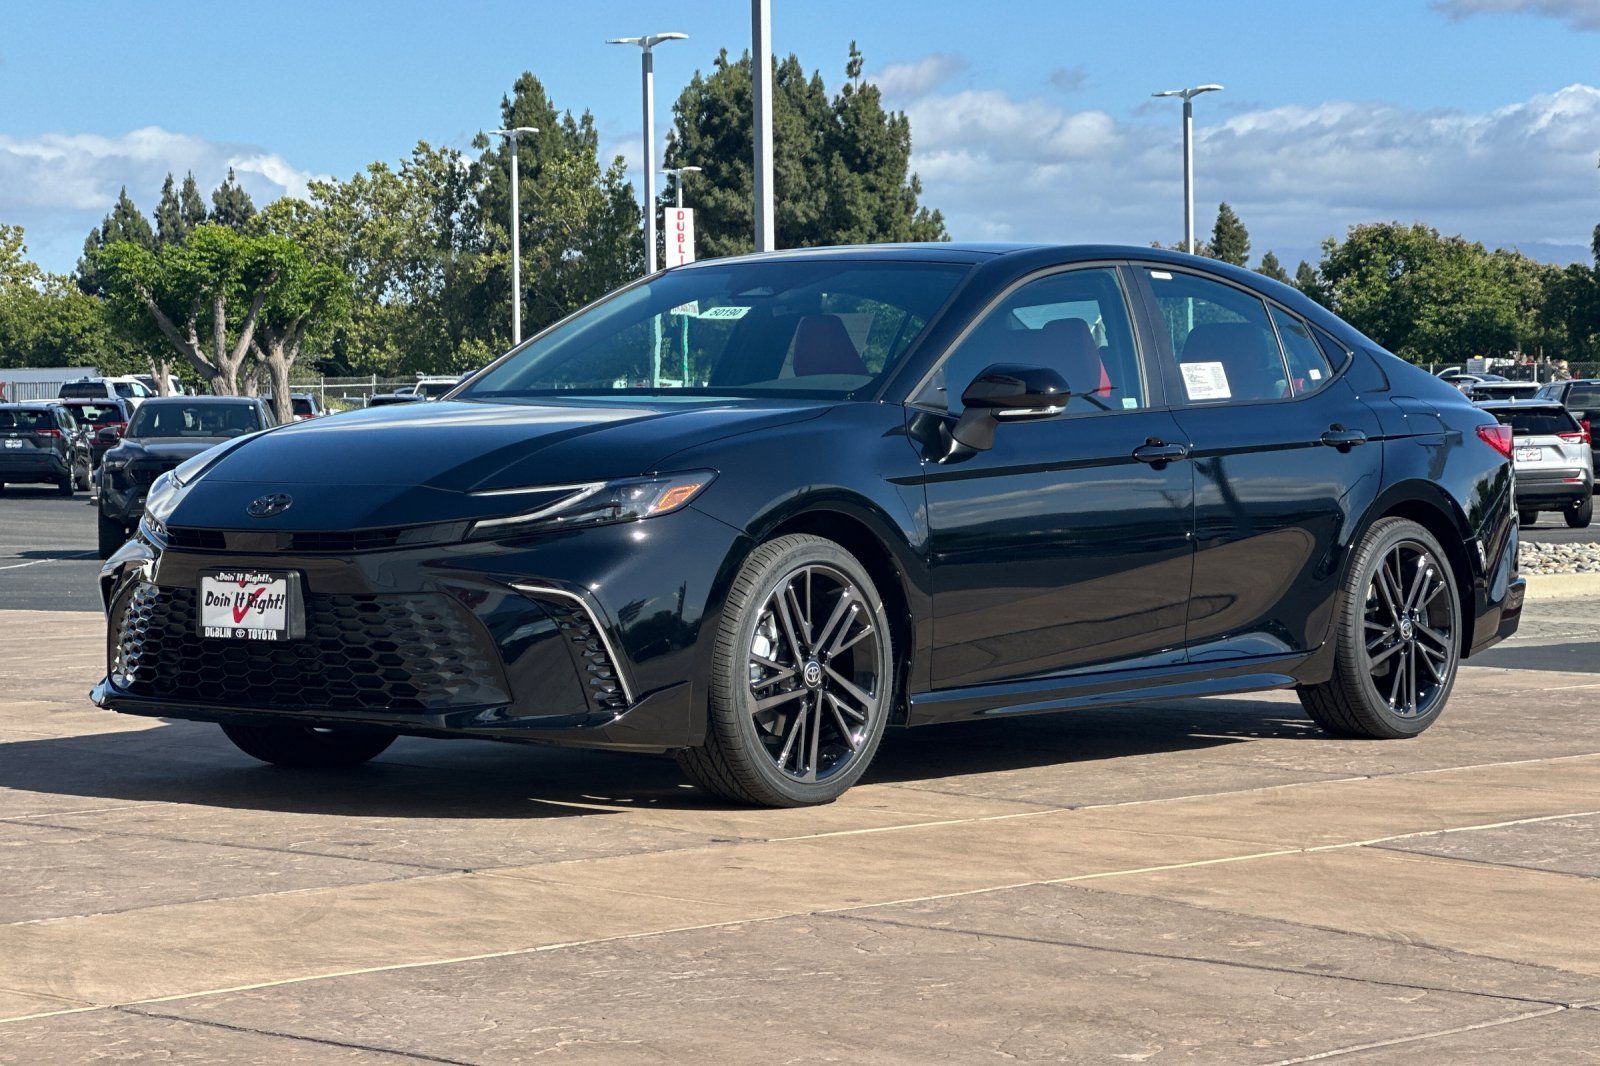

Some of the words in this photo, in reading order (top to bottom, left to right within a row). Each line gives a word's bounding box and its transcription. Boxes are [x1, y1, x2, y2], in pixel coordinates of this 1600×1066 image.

[709, 308, 743, 317] 50190
[236, 573, 245, 581] It
[244, 574, 269, 584] Right!
[205, 591, 233, 607] Doin'
[234, 592, 245, 608] It
[247, 593, 285, 614] Right!
[205, 627, 232, 638] DUBLIN
[247, 629, 277, 640] TOYOTA
